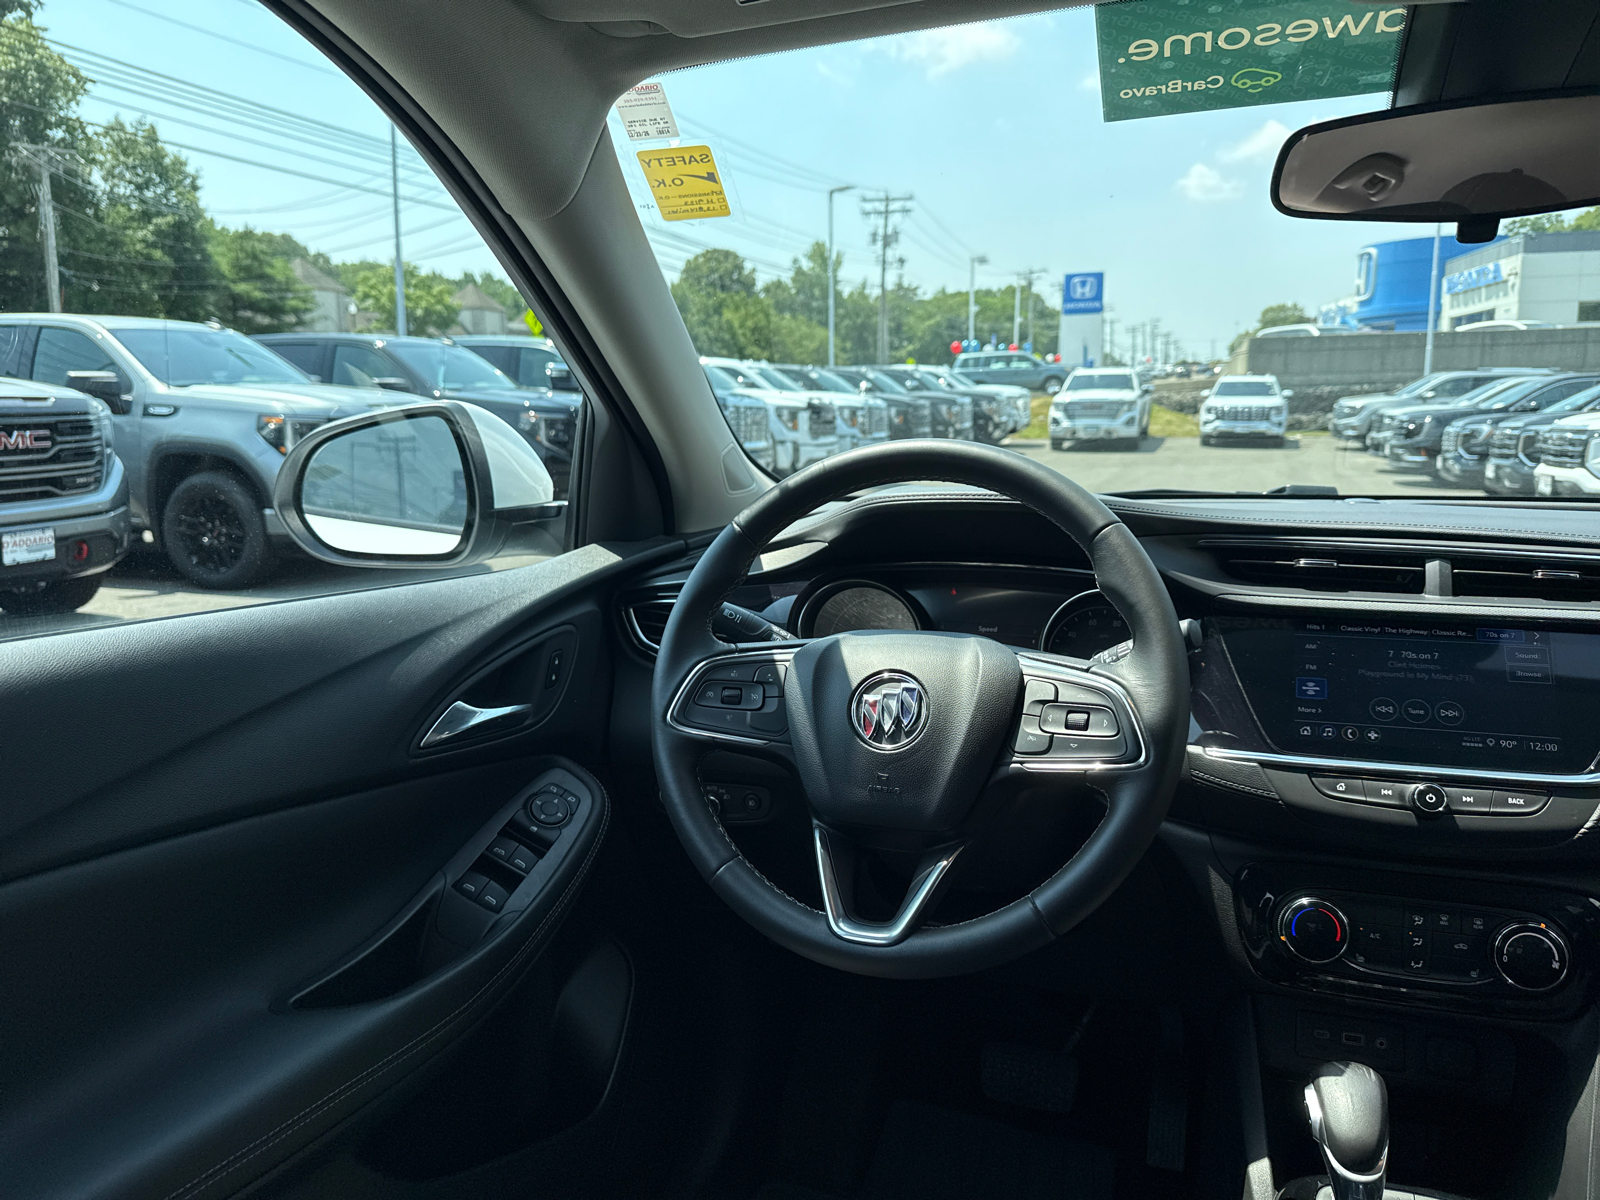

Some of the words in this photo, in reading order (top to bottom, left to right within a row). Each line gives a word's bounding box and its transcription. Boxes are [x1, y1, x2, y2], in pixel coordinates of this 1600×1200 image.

[978, 625, 998, 634] Speed
[1364, 626, 1380, 634] Vinyl
[1398, 628, 1428, 636] Highway
[1388, 650, 1394, 658] 7
[1400, 650, 1417, 659] 70s
[1433, 652, 1438, 660] 7
[1515, 652, 1538, 660] Sound
[1358, 668, 1404, 678] Playground
[1516, 670, 1542, 678] Browse
[1530, 742, 1558, 752] 12:00
[1369, 932, 1381, 940] A/C
